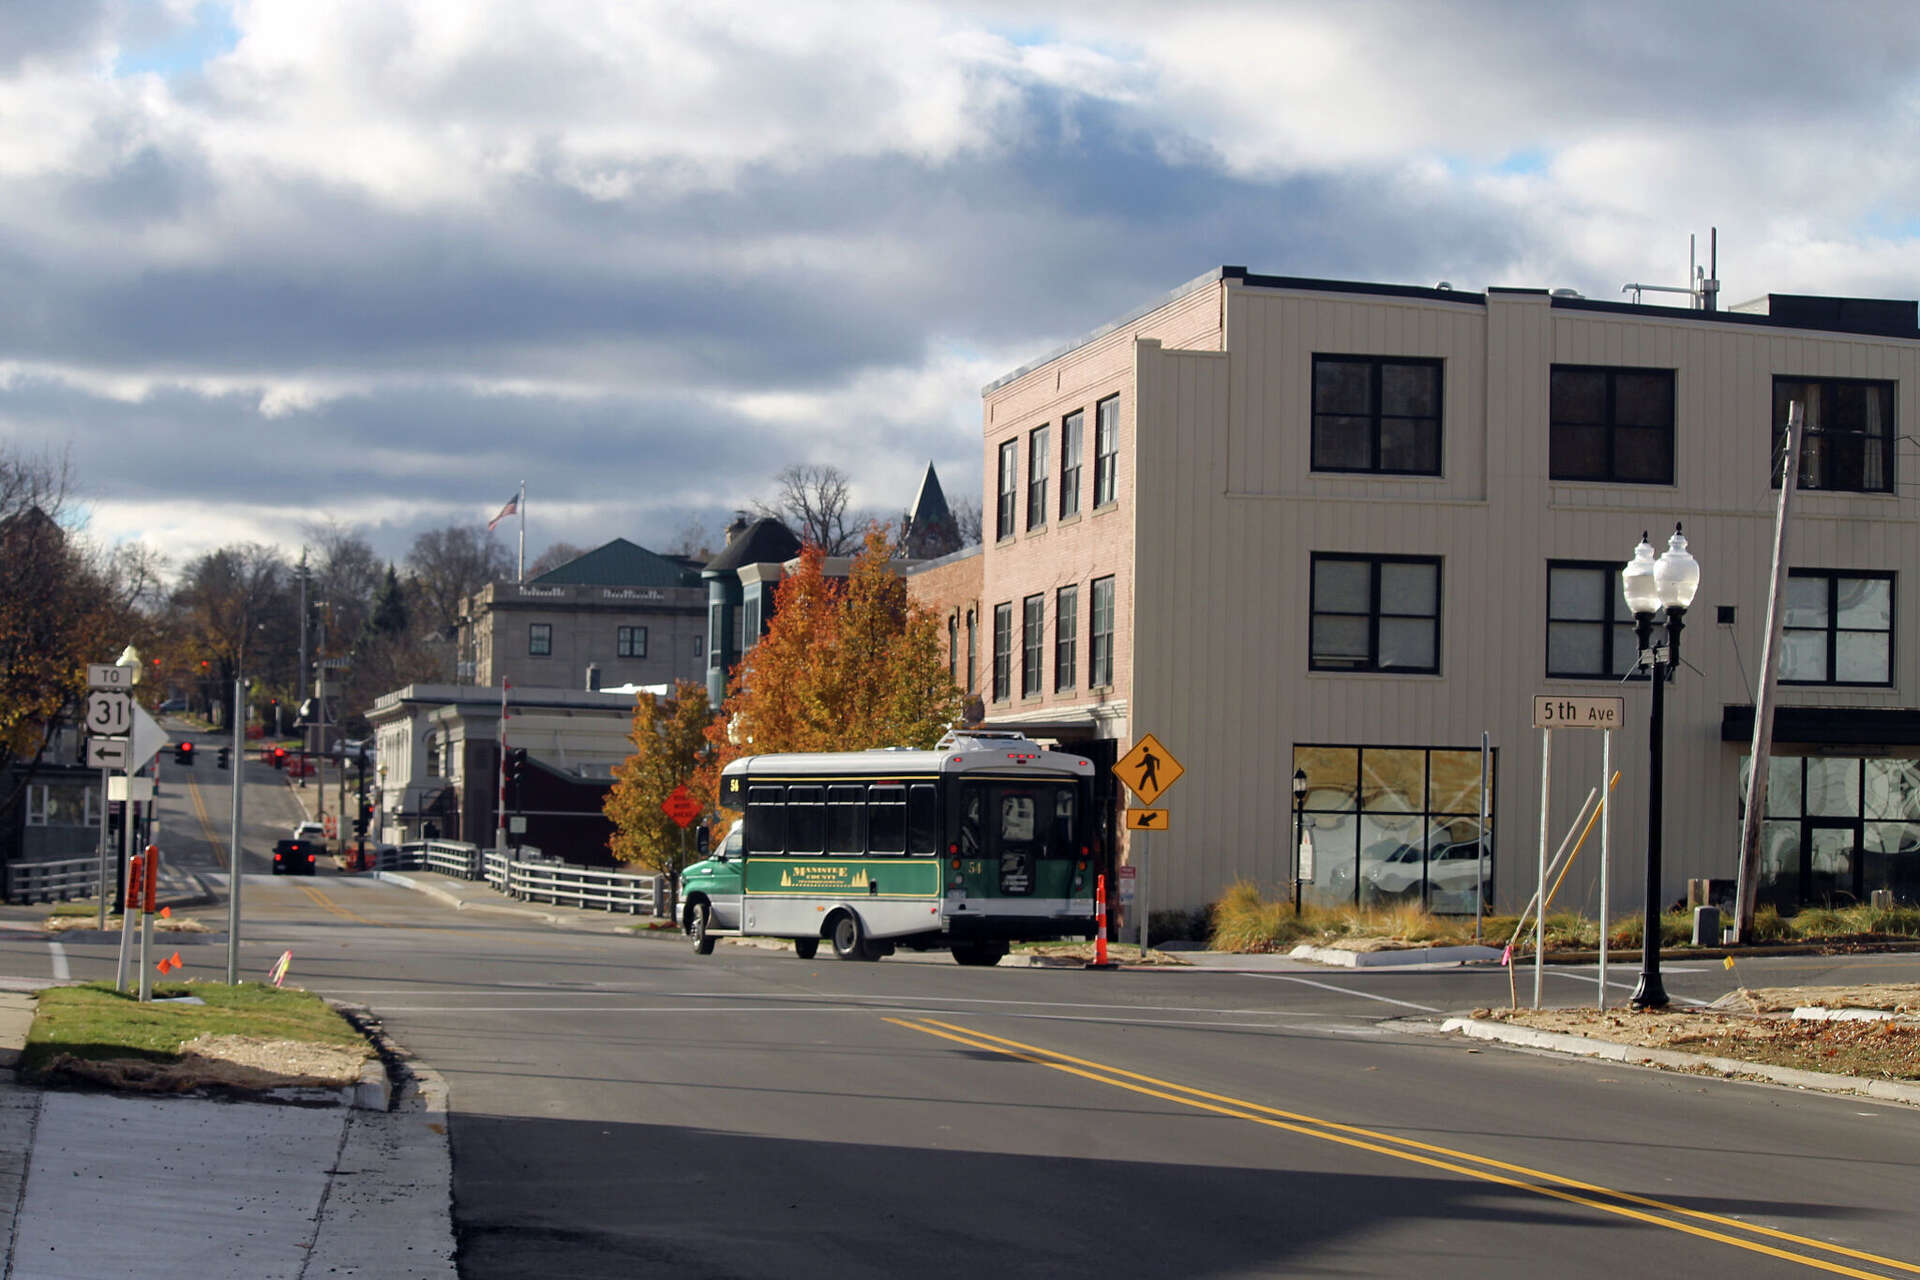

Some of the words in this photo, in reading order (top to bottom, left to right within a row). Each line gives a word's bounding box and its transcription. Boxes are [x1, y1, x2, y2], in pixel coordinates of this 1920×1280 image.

[102, 669, 120, 683] TO
[95, 700, 122, 725] 31
[1544, 701, 1576, 720] 5th
[1588, 706, 1614, 721] Ave
[730, 778, 739, 792] 54
[793, 867, 848, 877] MANISTEE
